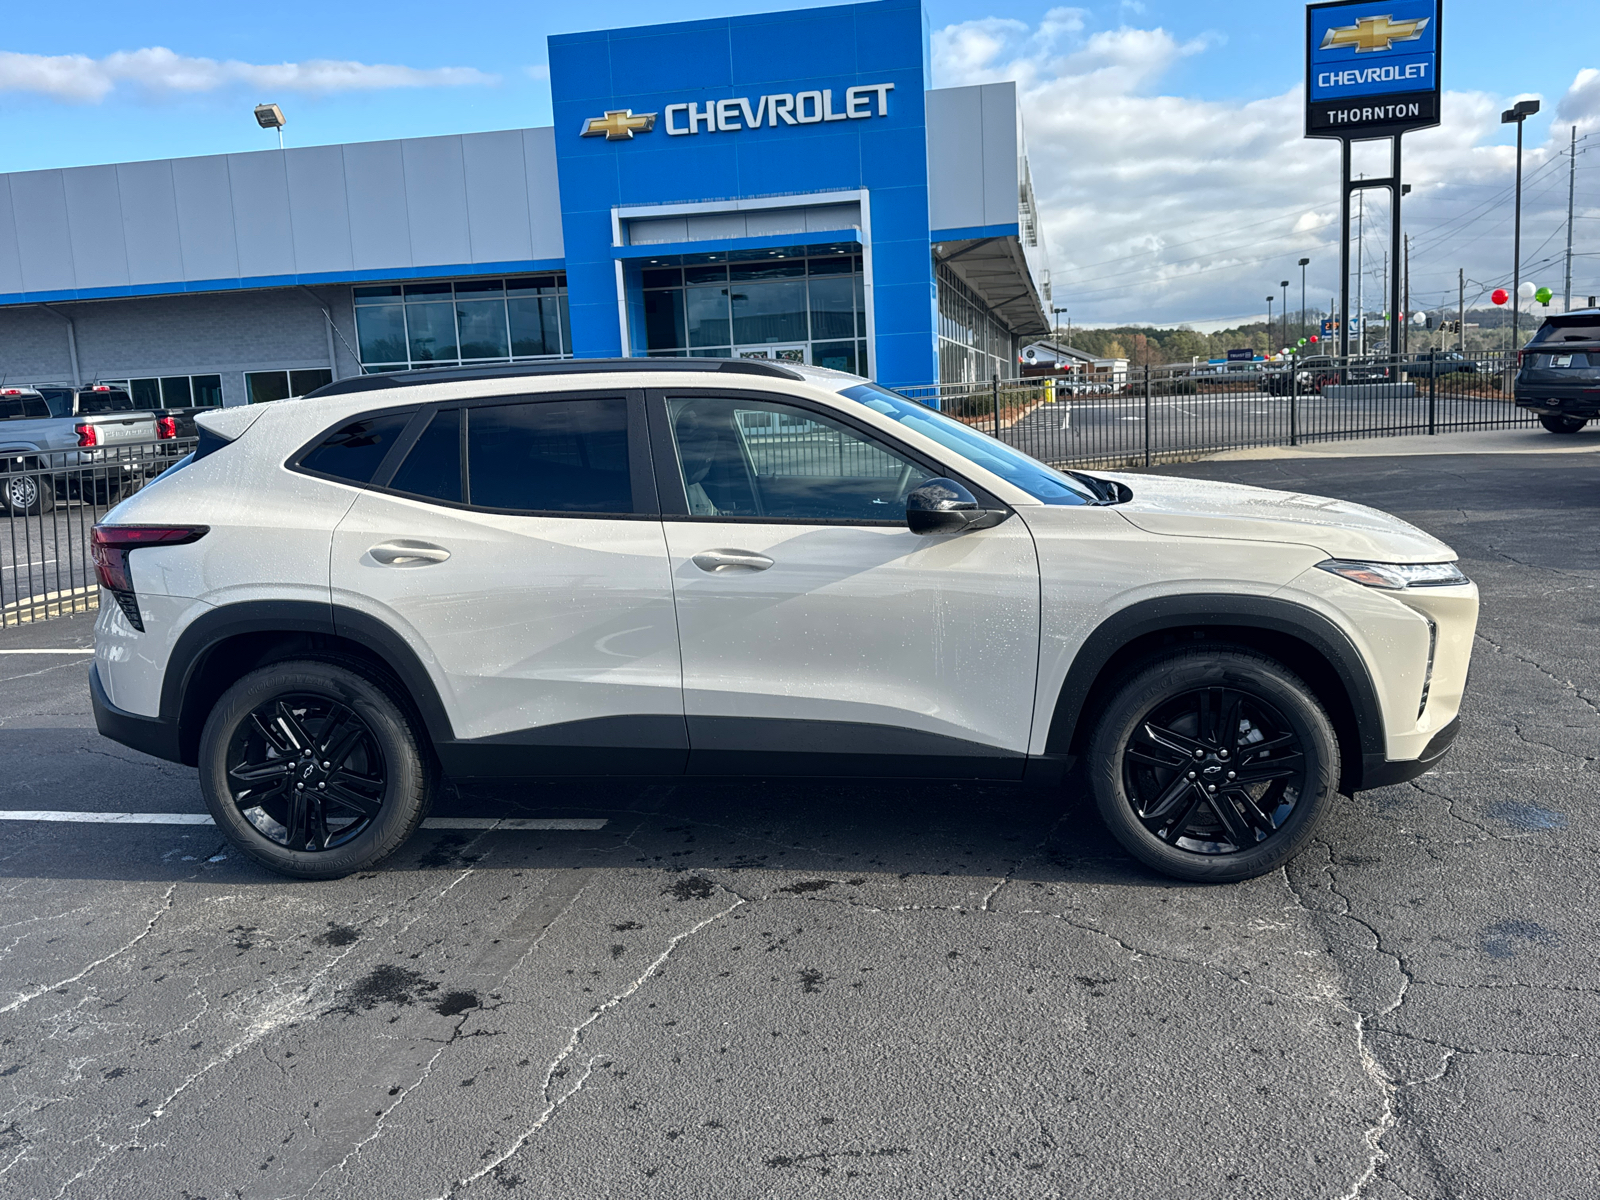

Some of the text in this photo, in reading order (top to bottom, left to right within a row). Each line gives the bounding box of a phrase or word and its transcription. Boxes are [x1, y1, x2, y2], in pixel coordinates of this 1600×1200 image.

[1318, 62, 1429, 88] CHEVROLET
[664, 82, 895, 136] CHEVROLET
[1327, 102, 1419, 124] THORNTON
